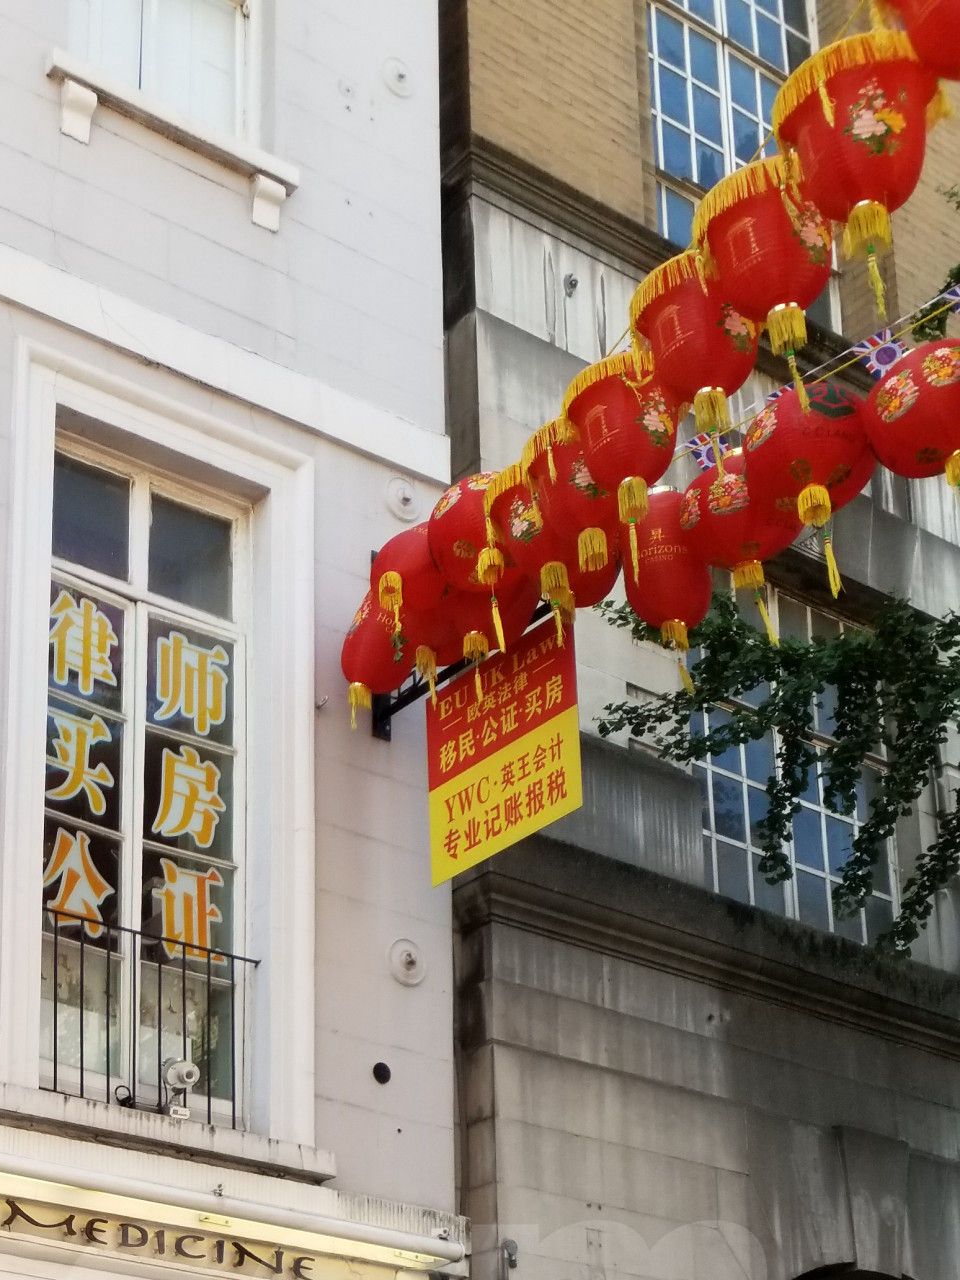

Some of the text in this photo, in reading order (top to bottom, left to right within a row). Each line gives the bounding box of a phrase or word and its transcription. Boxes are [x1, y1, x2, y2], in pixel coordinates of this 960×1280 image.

[439, 685, 469, 721] EU
[443, 766, 568, 861] 专业记账报税
